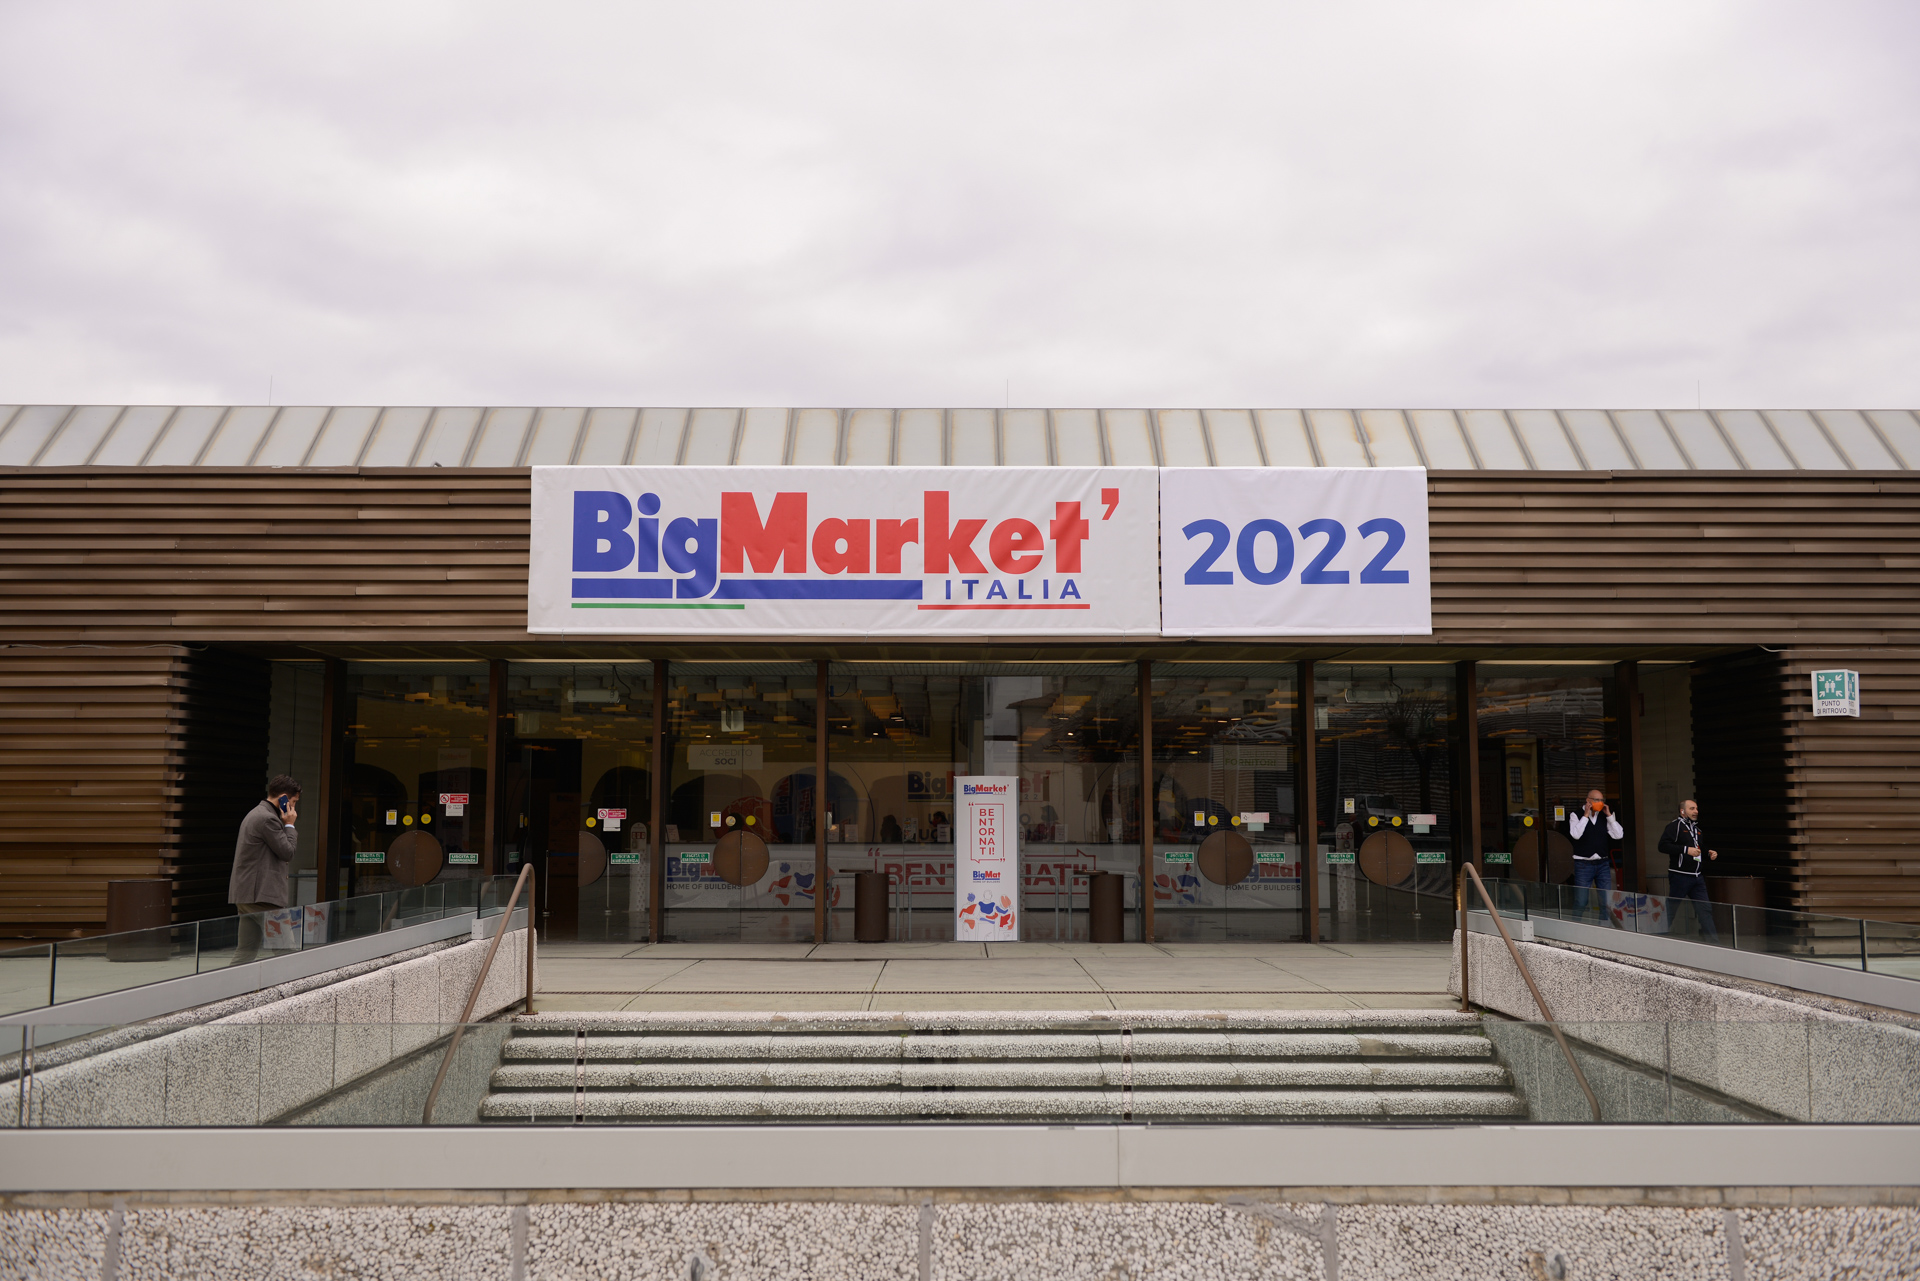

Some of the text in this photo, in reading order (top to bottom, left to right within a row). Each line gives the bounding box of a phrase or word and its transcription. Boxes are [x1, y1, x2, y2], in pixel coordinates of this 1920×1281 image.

[1182, 517, 1410, 586] 2022
[944, 579, 1083, 599] ITALIA
[714, 757, 737, 766] SOCI
[1225, 758, 1277, 766] FORNITORI
[979, 808, 995, 817] BE
[979, 818, 995, 826] NT
[979, 827, 995, 836] OR
[979, 837, 996, 846] NA
[973, 870, 1001, 881] BigMat
